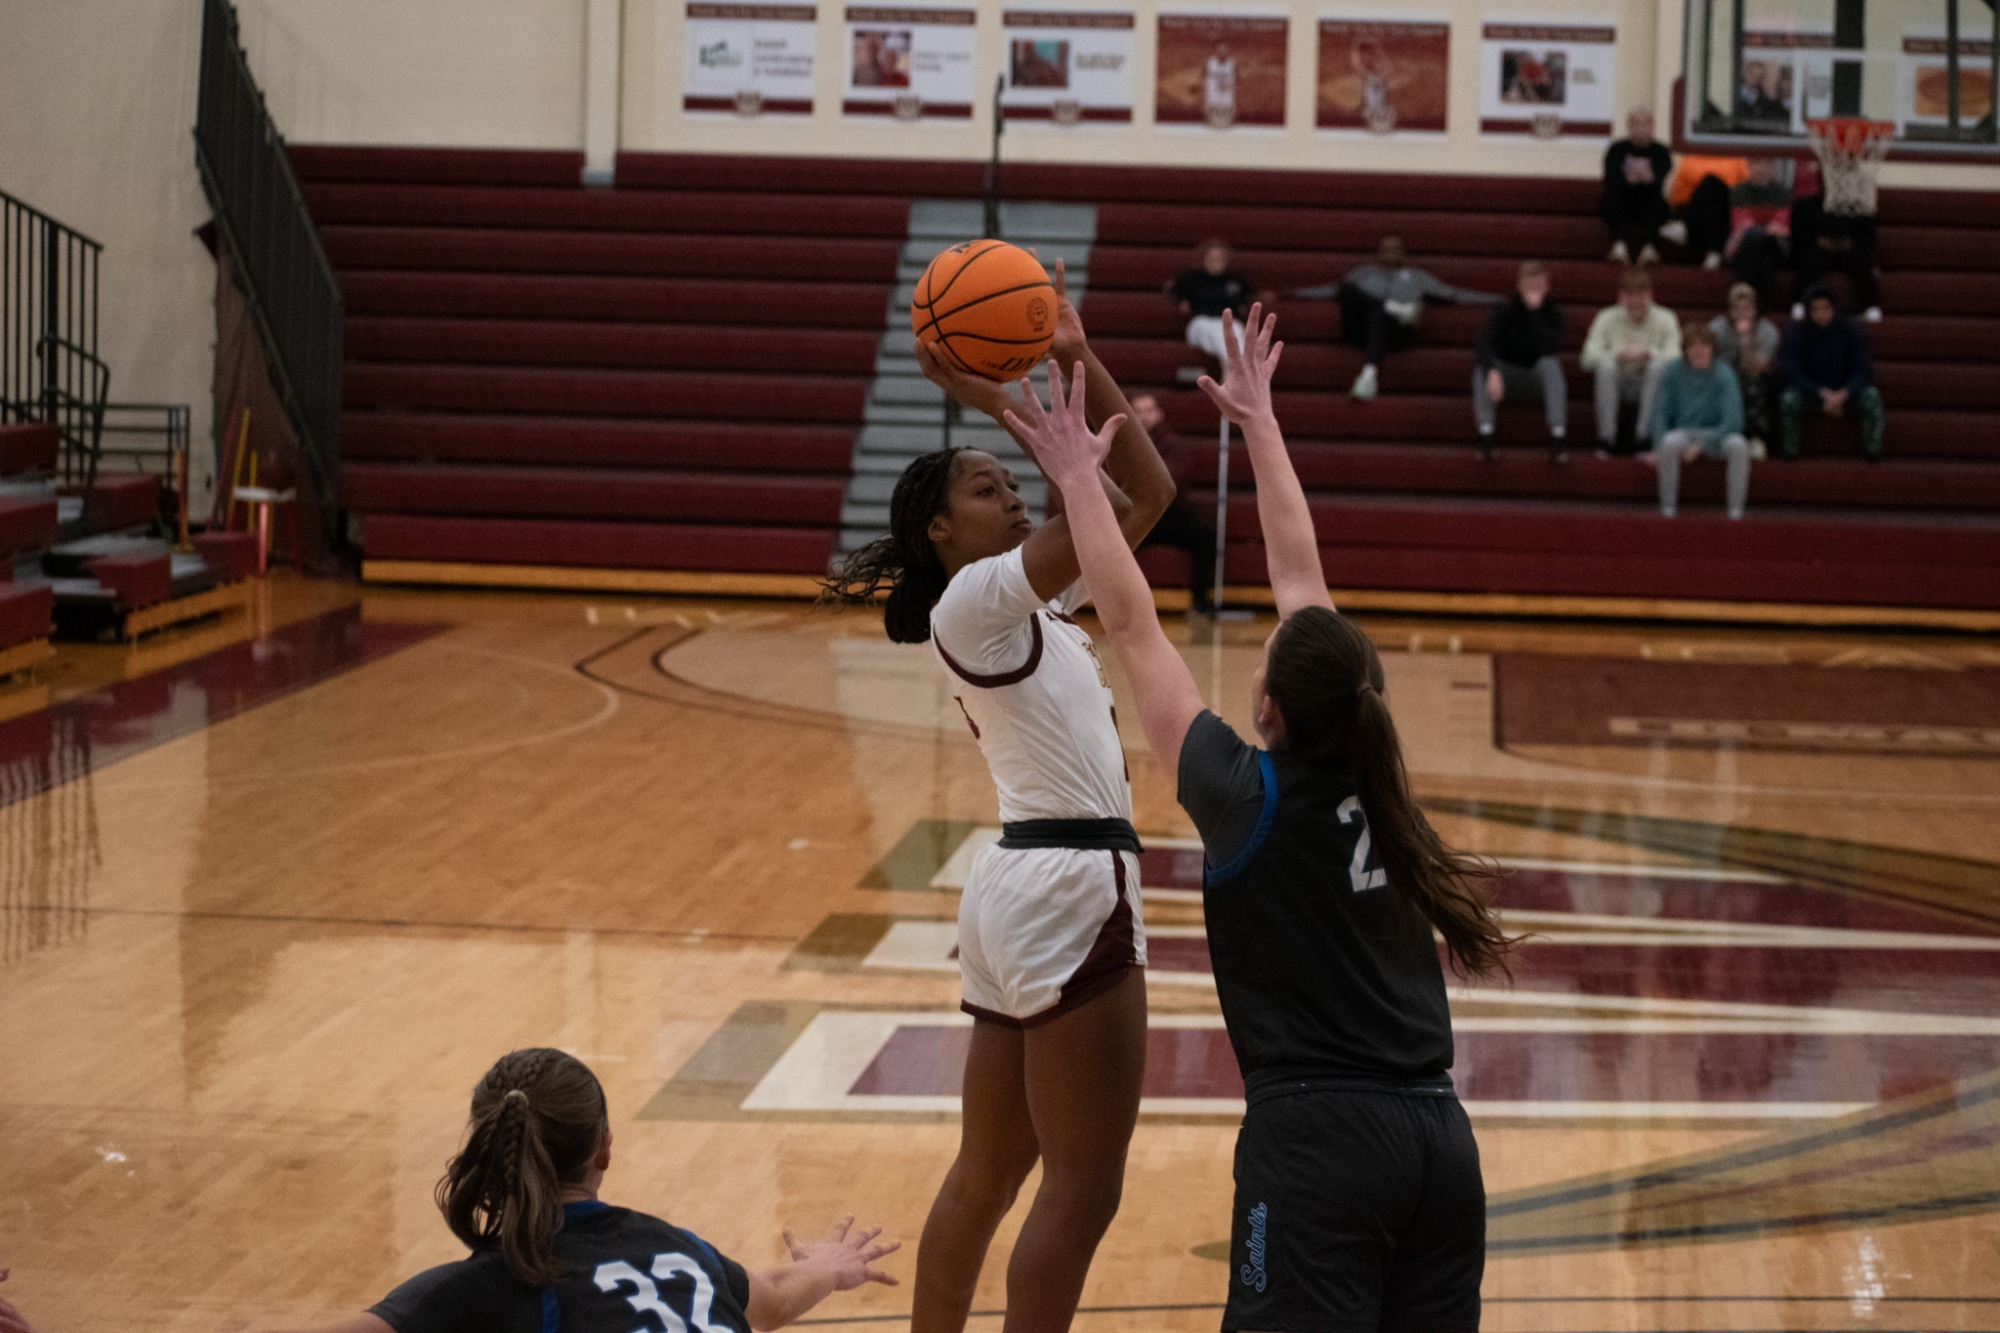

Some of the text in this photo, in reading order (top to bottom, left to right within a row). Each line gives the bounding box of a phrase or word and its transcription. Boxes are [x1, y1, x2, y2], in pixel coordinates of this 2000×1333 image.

[1335, 794, 1388, 893] 2
[592, 1251, 736, 1333] 32
[1240, 1201, 1268, 1293] Saints
